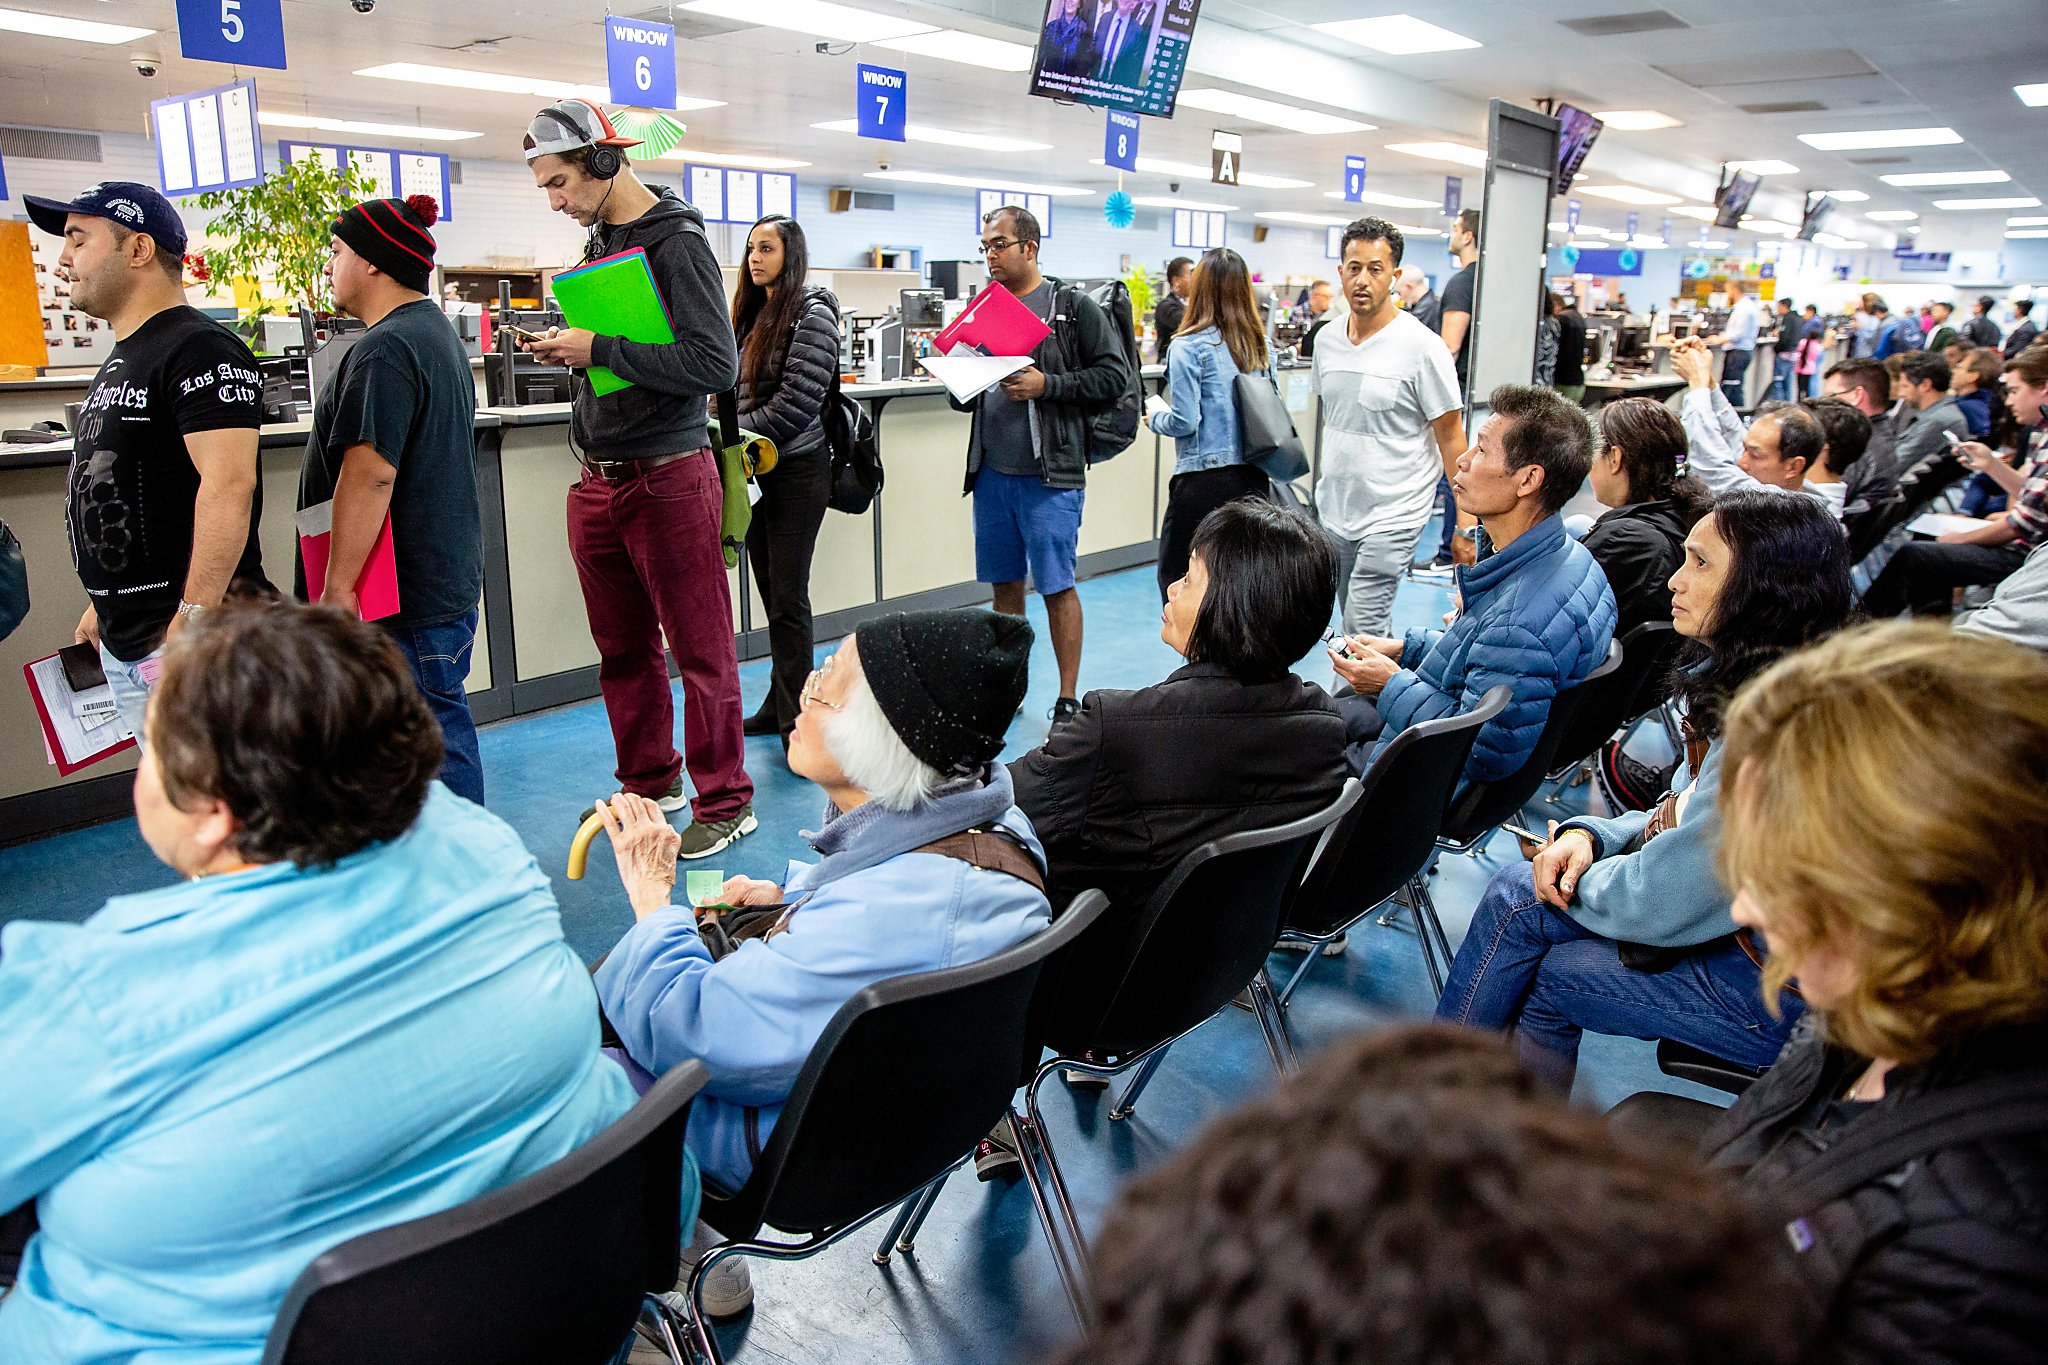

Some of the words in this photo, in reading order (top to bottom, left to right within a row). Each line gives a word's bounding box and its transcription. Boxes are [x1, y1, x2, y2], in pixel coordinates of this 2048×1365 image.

[221, 0, 244, 42] 5
[613, 26, 668, 46] WINDOW
[635, 56, 651, 90] 6
[862, 70, 902, 89] WINDOW
[876, 96, 889, 124] 7
[1110, 112, 1138, 129] WINDOW
[1117, 134, 1127, 158] 8
[365, 153, 373, 163] B
[416, 158, 424, 168] C
[1219, 151, 1235, 182] A
[1351, 174, 1359, 194] 9
[114, 209, 133, 222] NYC
[180, 369, 214, 396] Los
[89, 381, 149, 411] Angeles
[218, 384, 256, 405] City
[78, 411, 104, 446] City
